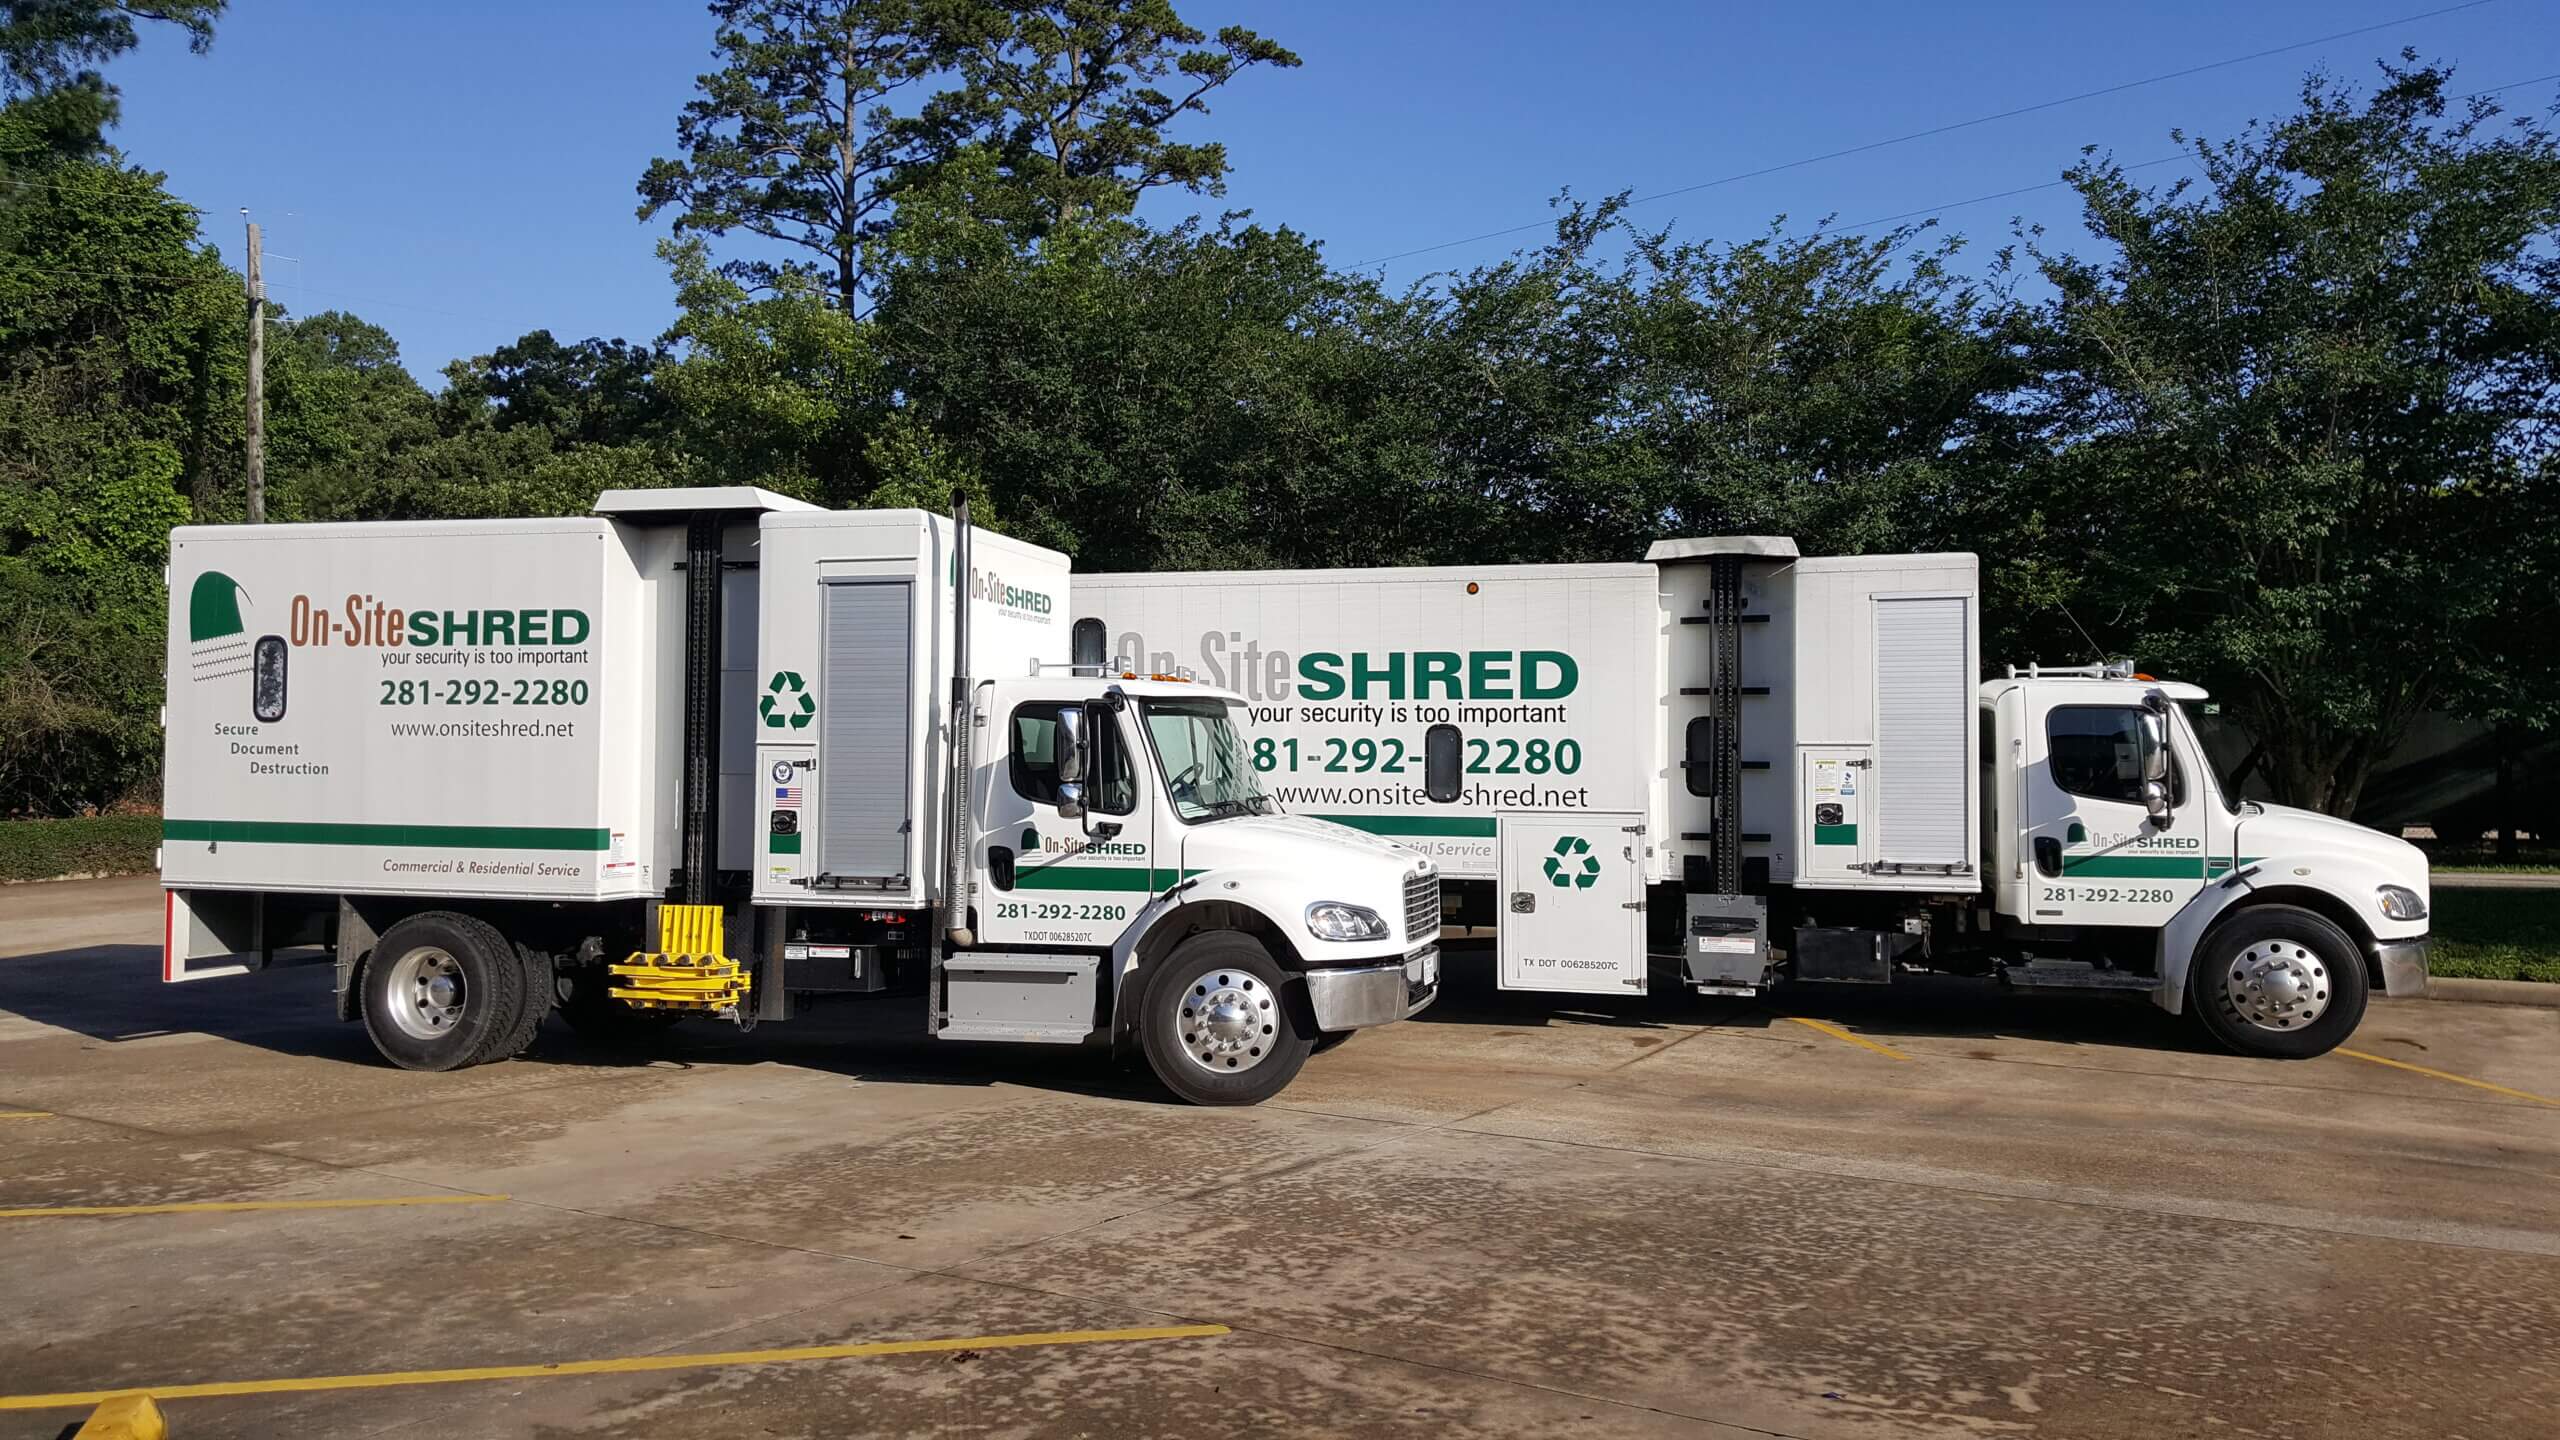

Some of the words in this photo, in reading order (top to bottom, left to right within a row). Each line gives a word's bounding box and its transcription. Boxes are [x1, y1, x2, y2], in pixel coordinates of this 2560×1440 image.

[381, 652, 410, 667] your
[415, 648, 470, 667] security
[475, 649, 485, 664] is
[490, 651, 513, 664] too
[517, 648, 588, 667] important
[380, 679, 589, 705] 281-292-2280
[1248, 707, 1293, 727] your
[1301, 702, 1383, 727] security
[1391, 702, 1407, 722] is
[1415, 705, 1449, 722] too
[1458, 702, 1566, 727] important
[214, 723, 259, 735] Secure
[391, 720, 574, 737] www.onsiteshred.net
[231, 742, 299, 755] Document
[250, 762, 329, 775] Destruction
[1436, 843, 1491, 856] Service
[383, 859, 453, 873] Commercial
[456, 861, 465, 873] &
[469, 861, 534, 876] Residential
[537, 863, 580, 877] Service
[2043, 888, 2174, 903] 281-292-2280
[997, 903, 1126, 920] 281-292-2280
[1024, 931, 1048, 941] TXDOT
[1523, 958, 1535, 967] TX
[1538, 959, 1557, 968] DOT
[1560, 960, 1618, 970] 006285207C
